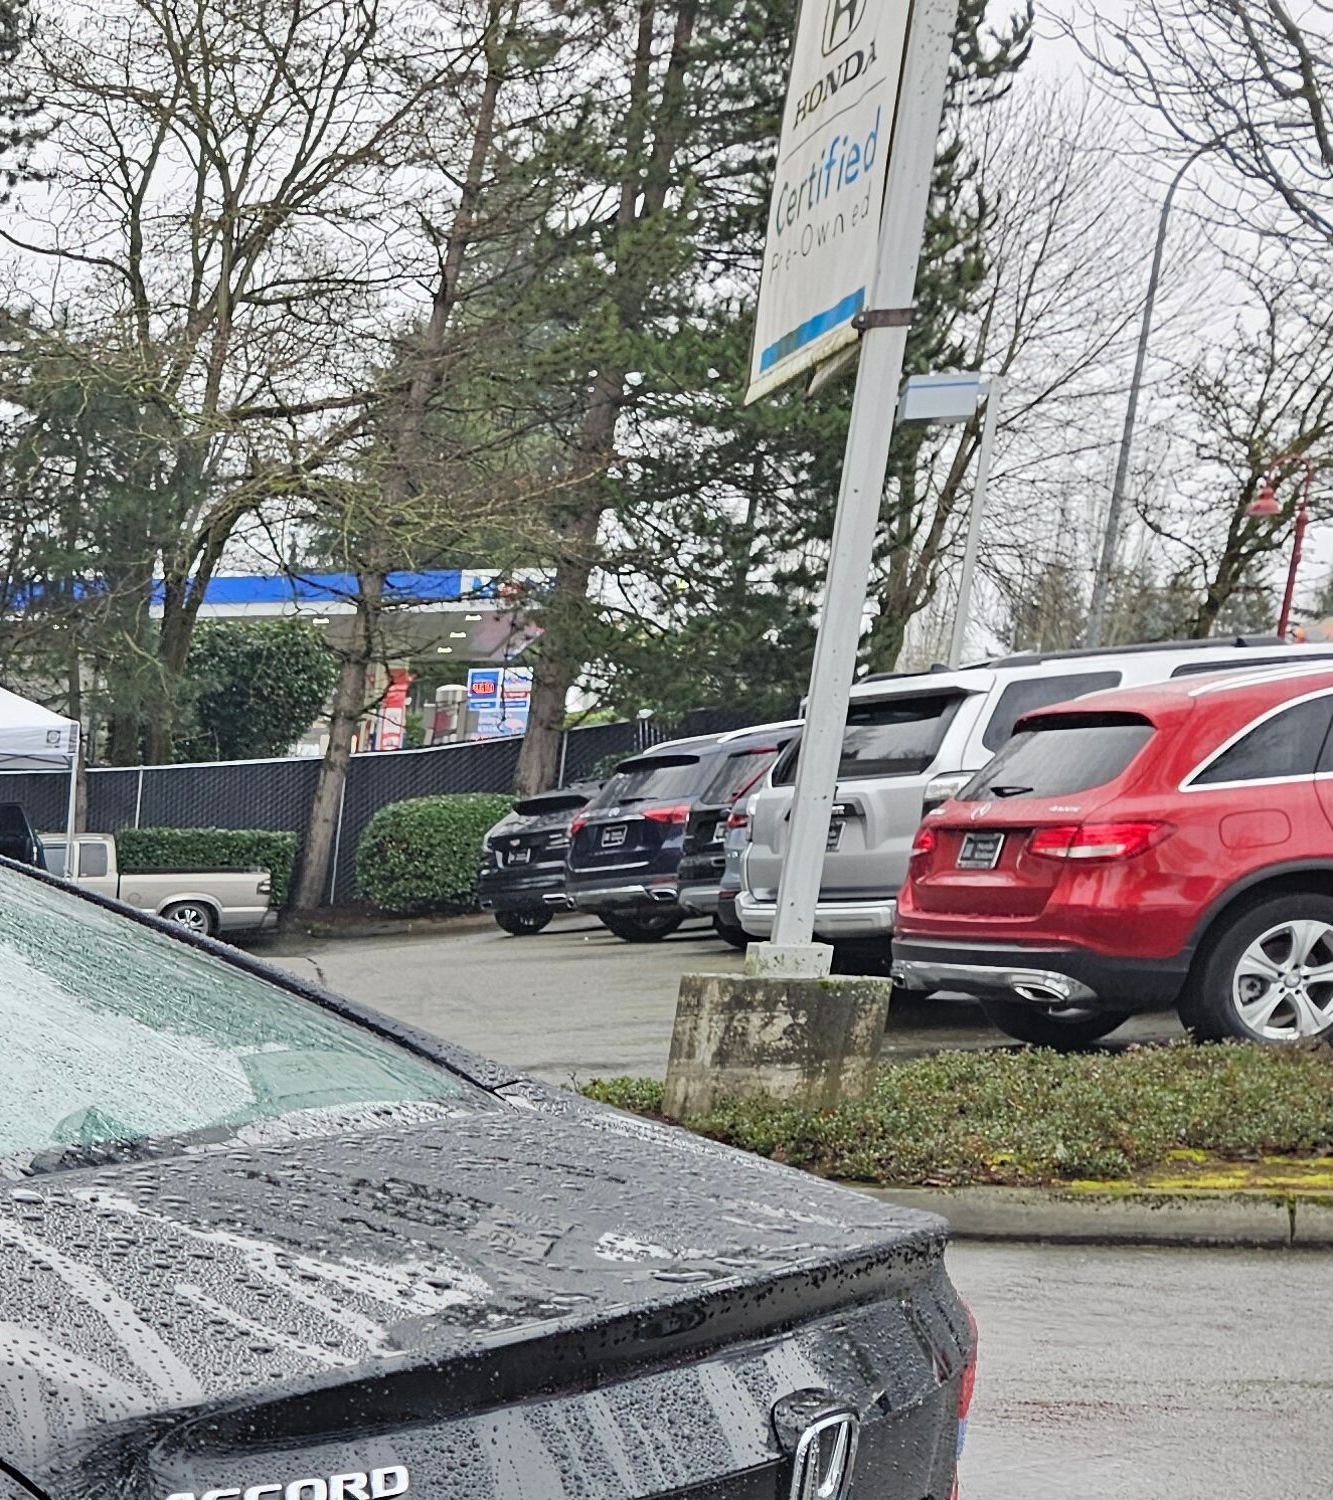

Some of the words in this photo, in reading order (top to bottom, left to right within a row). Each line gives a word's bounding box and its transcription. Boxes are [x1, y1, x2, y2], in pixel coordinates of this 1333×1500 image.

[793, 40, 877, 130] HONDA
[776, 104, 882, 237] Certified
[770, 180, 871, 284] Pre-Owned
